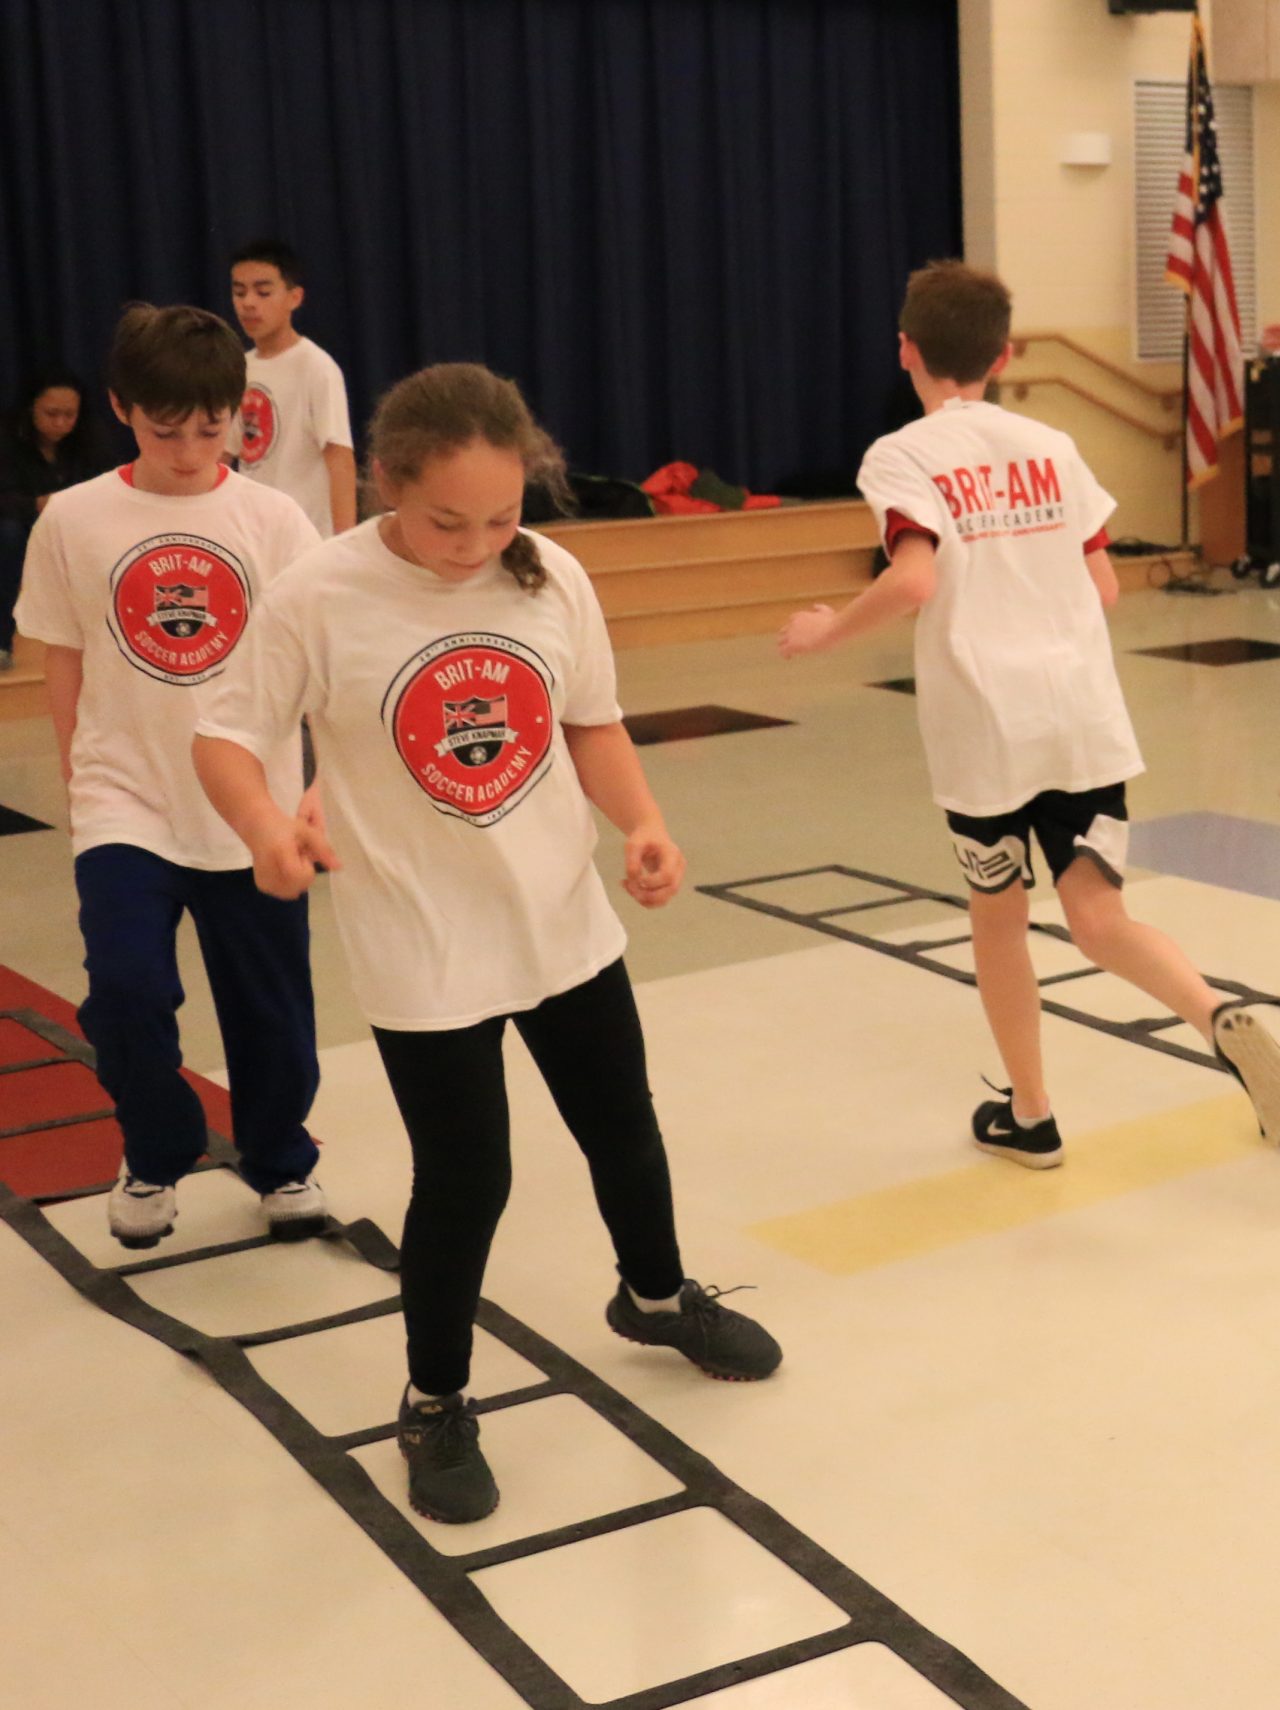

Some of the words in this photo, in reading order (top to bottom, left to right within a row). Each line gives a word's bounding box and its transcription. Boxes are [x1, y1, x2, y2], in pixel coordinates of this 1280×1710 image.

[1003, 506, 1065, 528] CADEMY
[148, 553, 214, 577] BRIT-AM
[134, 630, 177, 666] SOCCER
[179, 630, 229, 666] ACADEMY
[433, 658, 511, 691] BRIT-AM
[421, 762, 474, 803] SOCCER
[477, 745, 533, 802] ACADEMY
